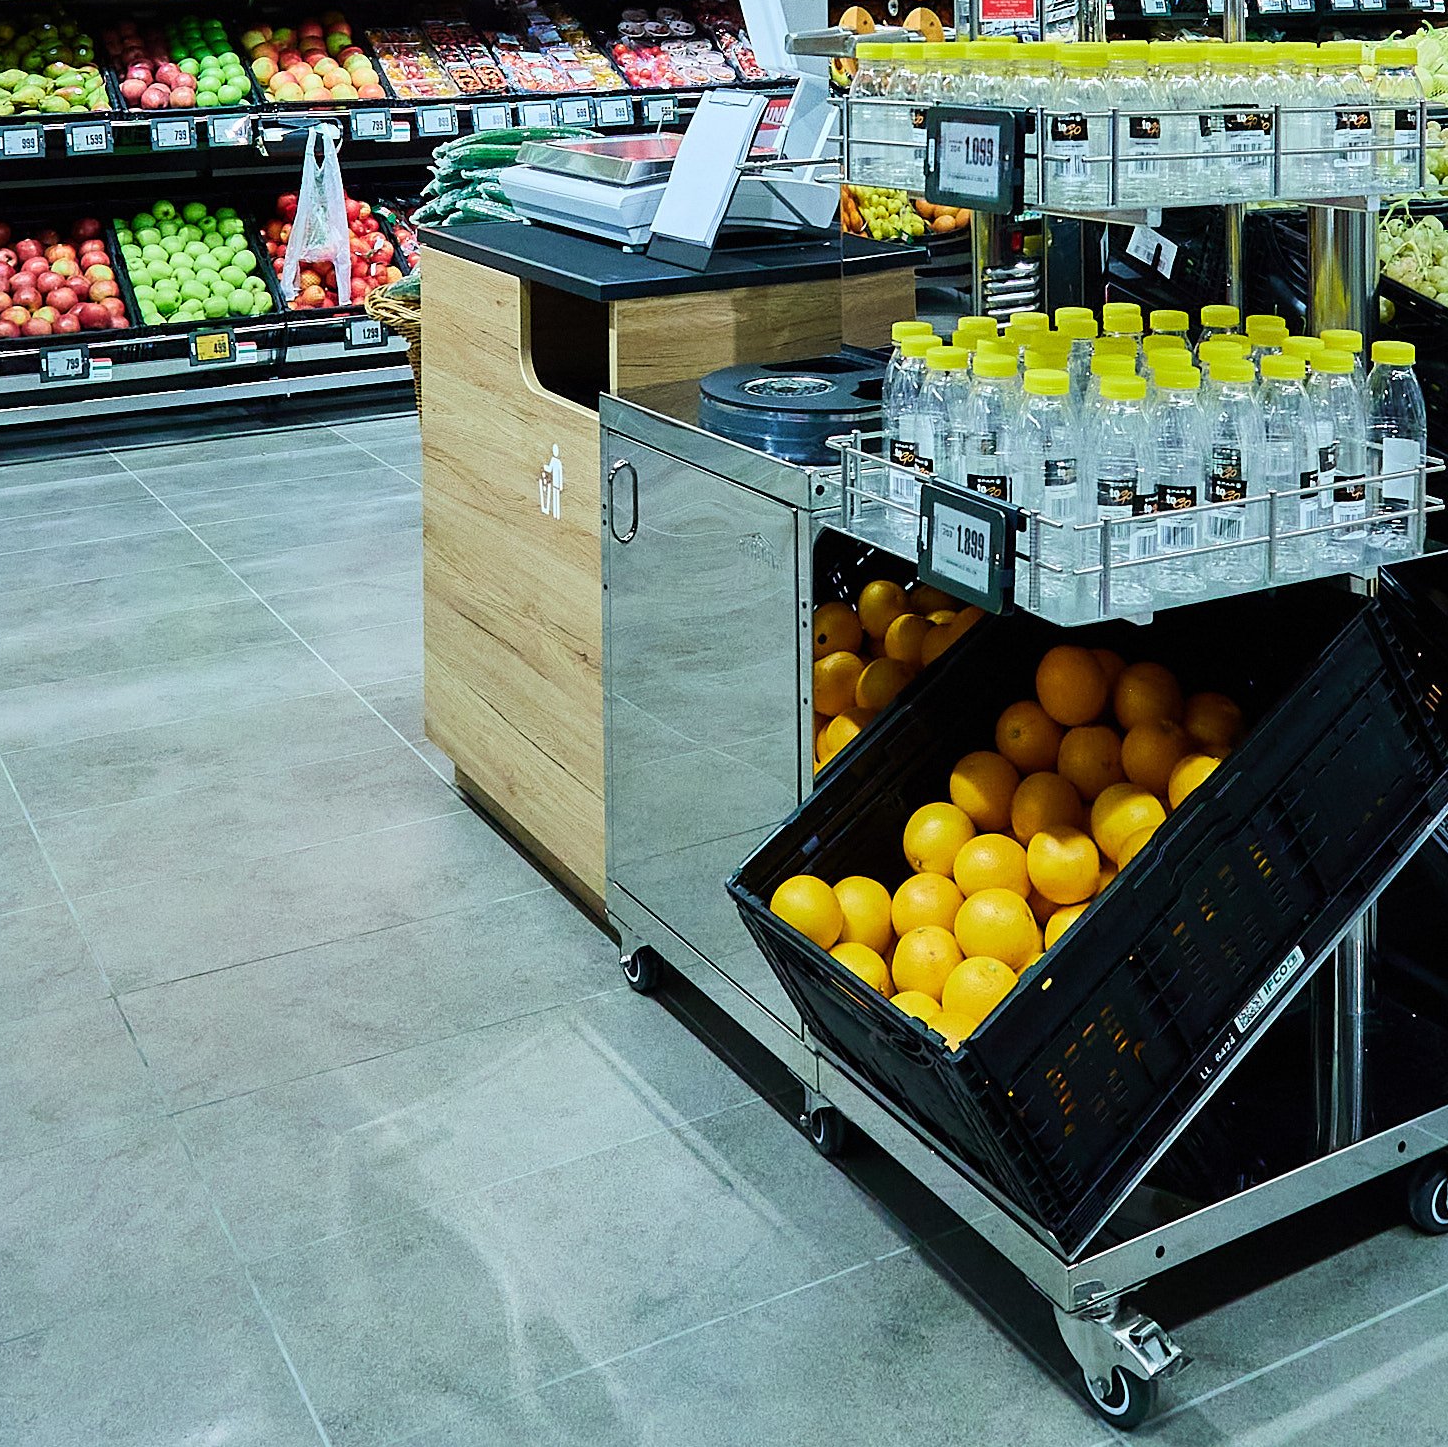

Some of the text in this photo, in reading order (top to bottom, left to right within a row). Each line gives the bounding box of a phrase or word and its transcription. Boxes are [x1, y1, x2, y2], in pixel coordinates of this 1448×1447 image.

[372, 121, 384, 132] 799
[84, 134, 103, 145] 1.599
[174, 130, 188, 141] 799
[21, 137, 35, 149] 999
[965, 136, 993, 166] 1.099
[362, 327, 379, 339] 1.299
[65, 357, 81, 370] 799
[1215, 486, 1225, 495] to
[1166, 495, 1176, 504] to
[957, 525, 984, 561] 1.899
[1263, 965, 1287, 995] IFCO
[1200, 1066, 1212, 1080] LL
